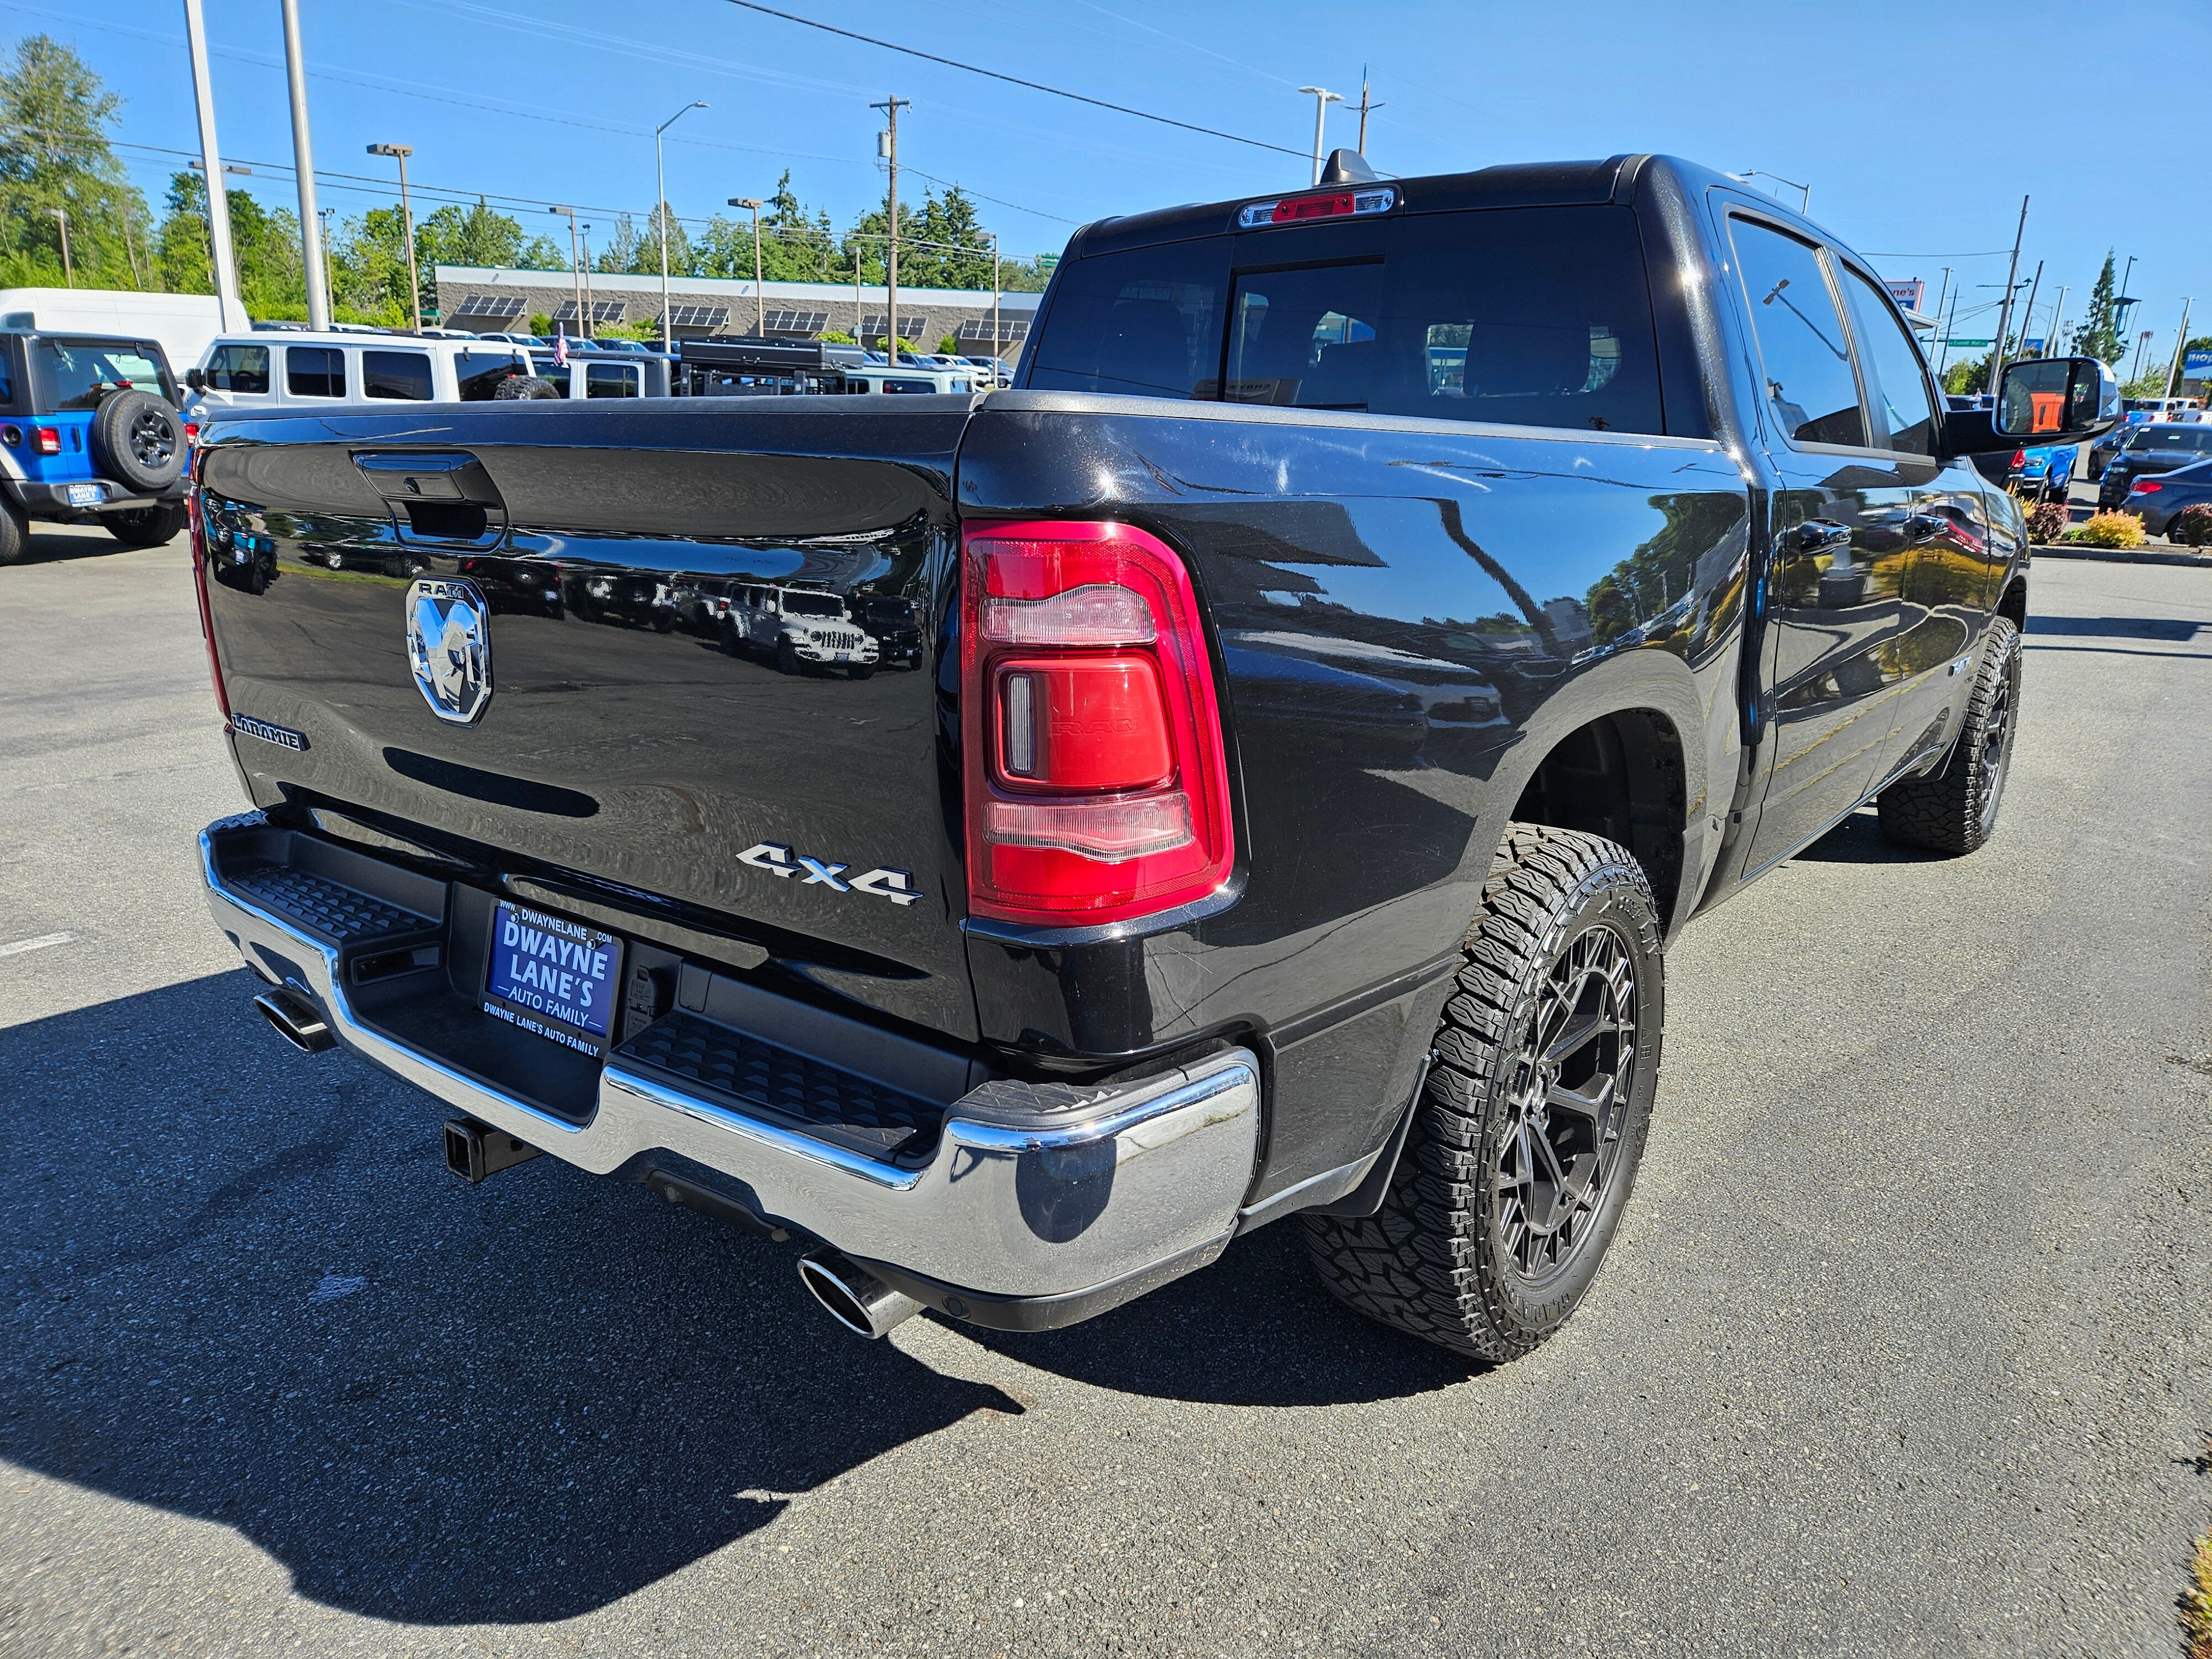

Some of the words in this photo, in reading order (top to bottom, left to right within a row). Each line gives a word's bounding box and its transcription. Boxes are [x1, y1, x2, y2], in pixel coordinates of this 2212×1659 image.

[419, 582, 464, 599] RAM
[232, 713, 300, 750] LARAMIE
[1051, 719, 1140, 735] RAM
[504, 920, 608, 980] DWAYNE
[510, 954, 594, 1007] LANE'S
[508, 986, 542, 1009] AUTO
[546, 1000, 589, 1027] FAMILY
[484, 1002, 514, 1023] DWAYNE
[517, 1015, 542, 1035] LANE'S
[544, 1028, 566, 1044] AUTO
[567, 1036, 599, 1057] FAMILY
